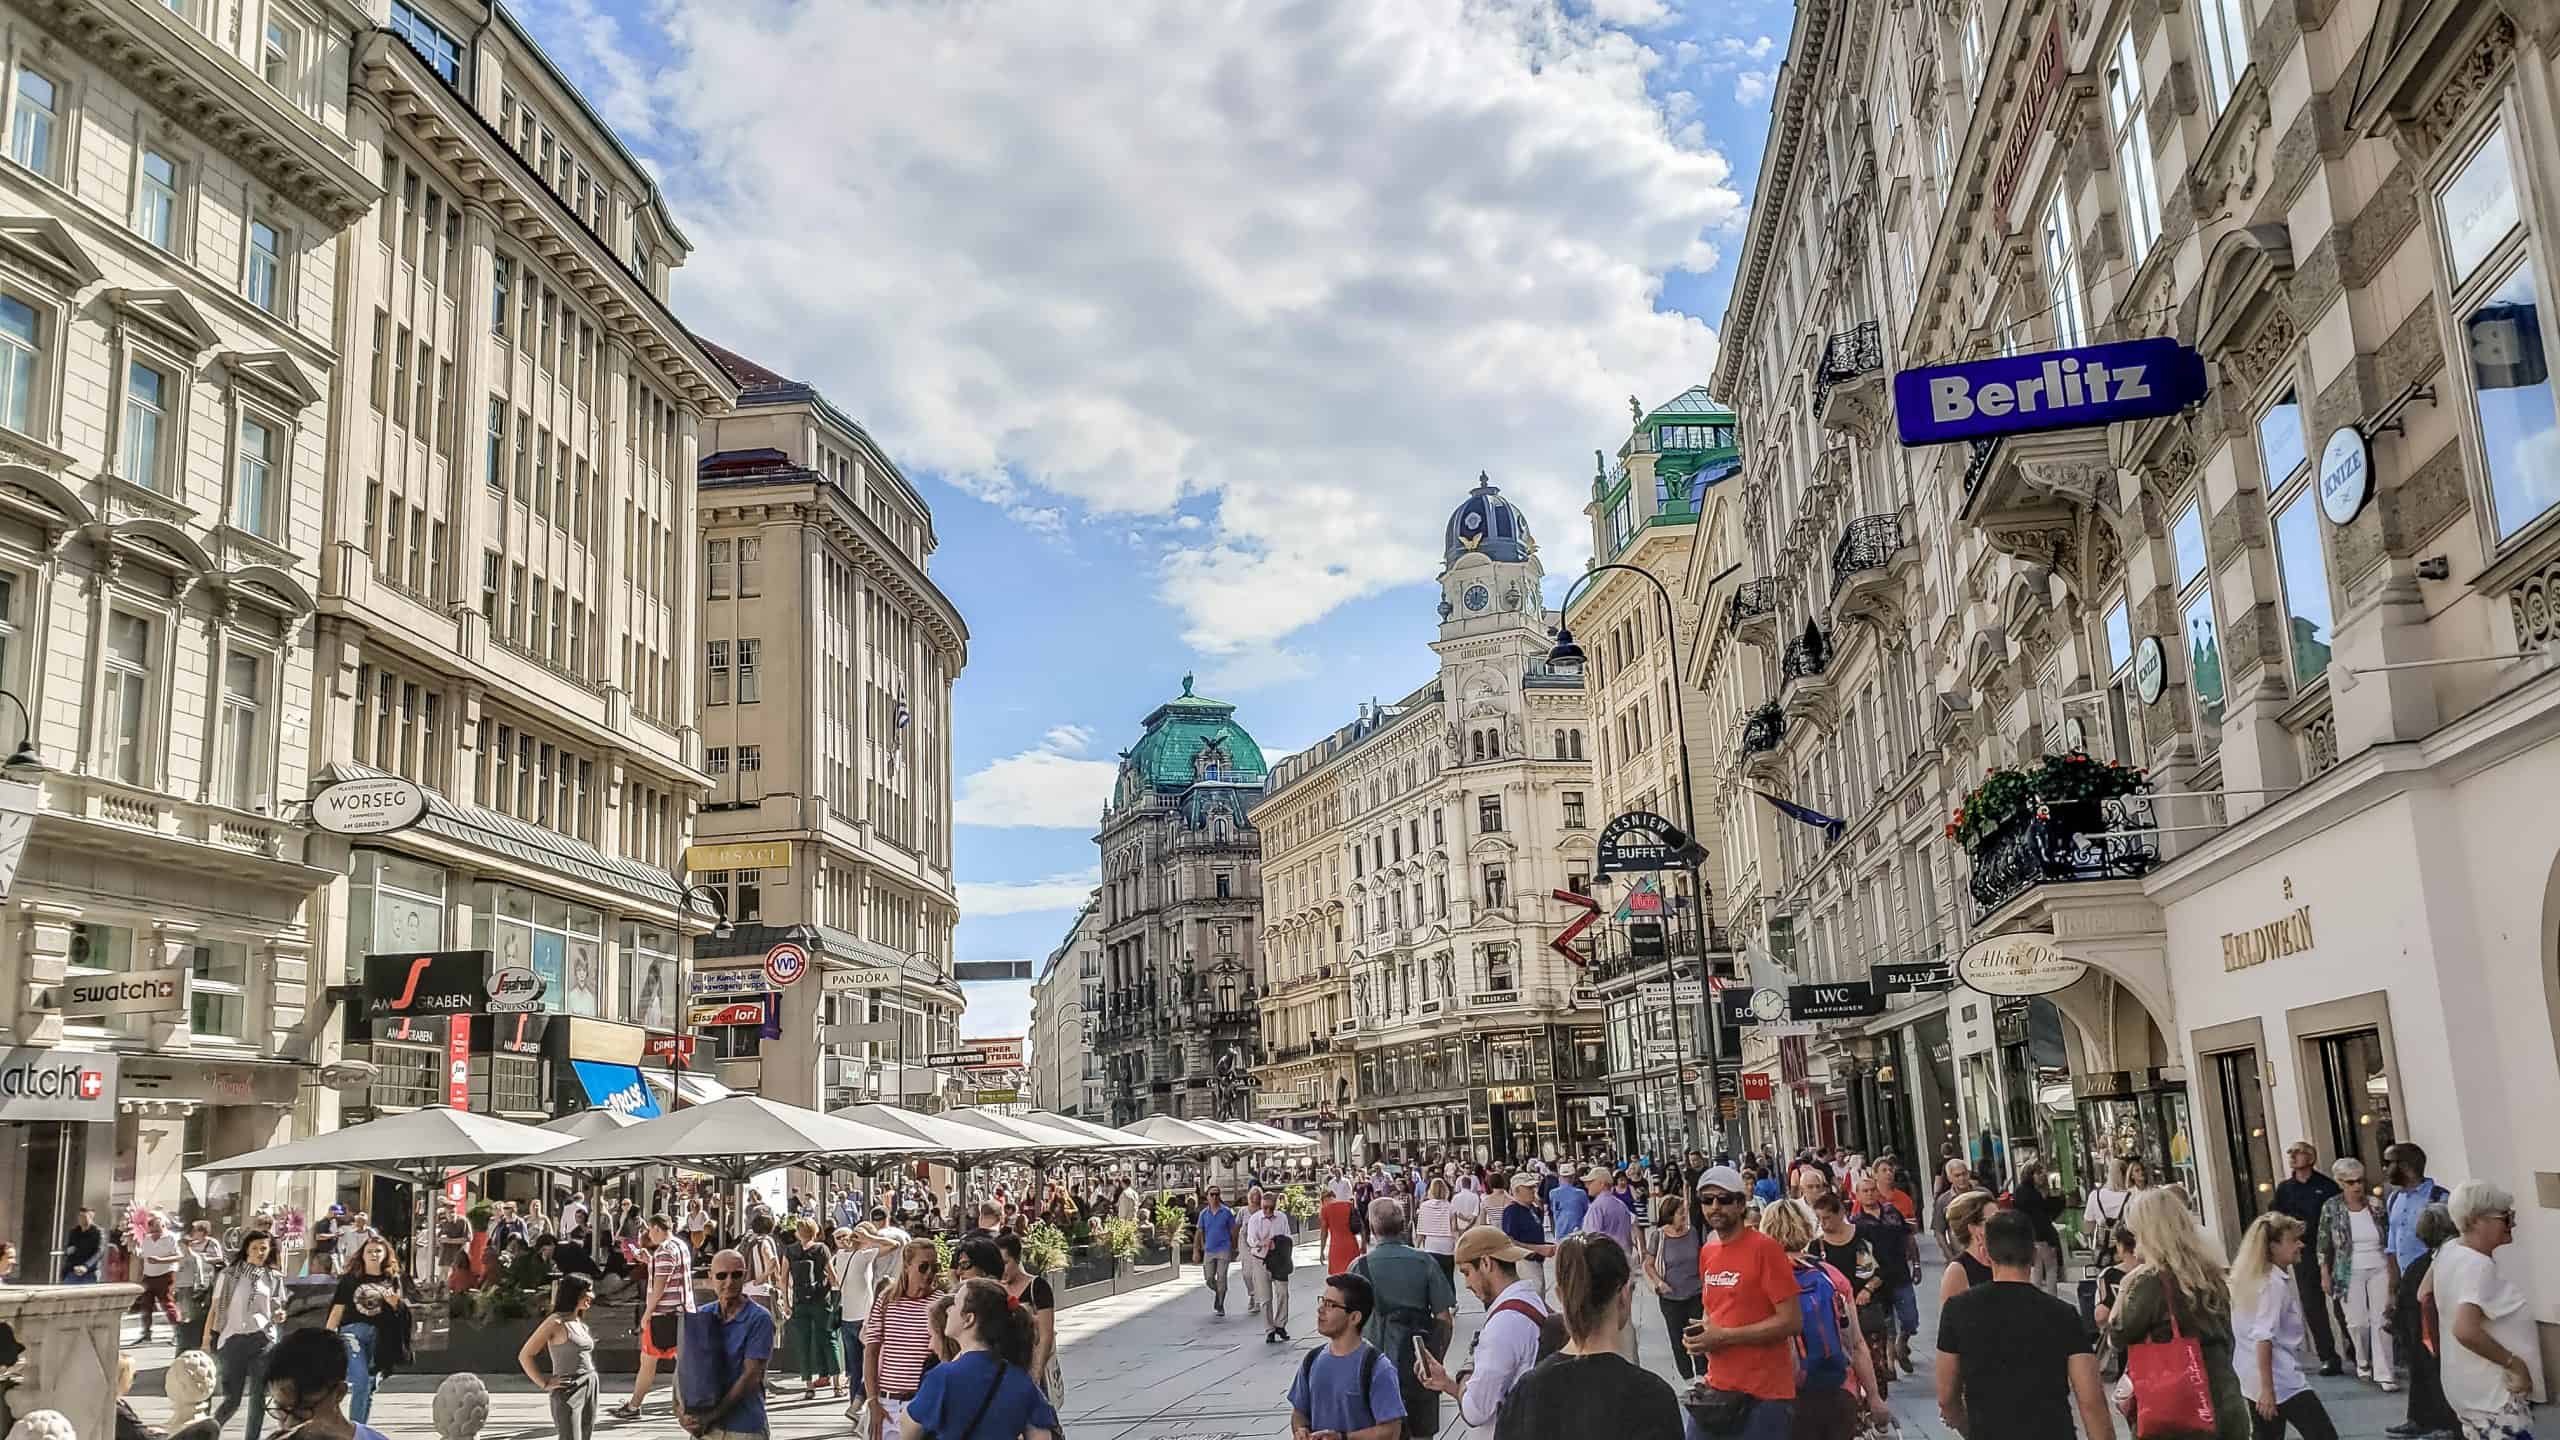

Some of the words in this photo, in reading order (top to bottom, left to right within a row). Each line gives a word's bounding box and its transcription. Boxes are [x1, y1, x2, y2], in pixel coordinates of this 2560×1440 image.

[1930, 357, 2151, 423] Berlitz
[2323, 449, 2362, 499] KNIZE
[329, 791, 407, 811] WORSEG
[1617, 847, 1666, 859] BUFFET
[1968, 949, 2020, 969] Albin
[1887, 973, 1934, 984] BALLY
[73, 980, 158, 1003] swatch
[1815, 988, 1849, 1004] IWC
[416, 994, 472, 1009] GRABEN
[1804, 1004, 1864, 1014] SCHAFFHAUSEN
[407, 1030, 433, 1042] GRABEN
[653, 1039, 685, 1052] CAMPI
[2, 1062, 82, 1098] atch
